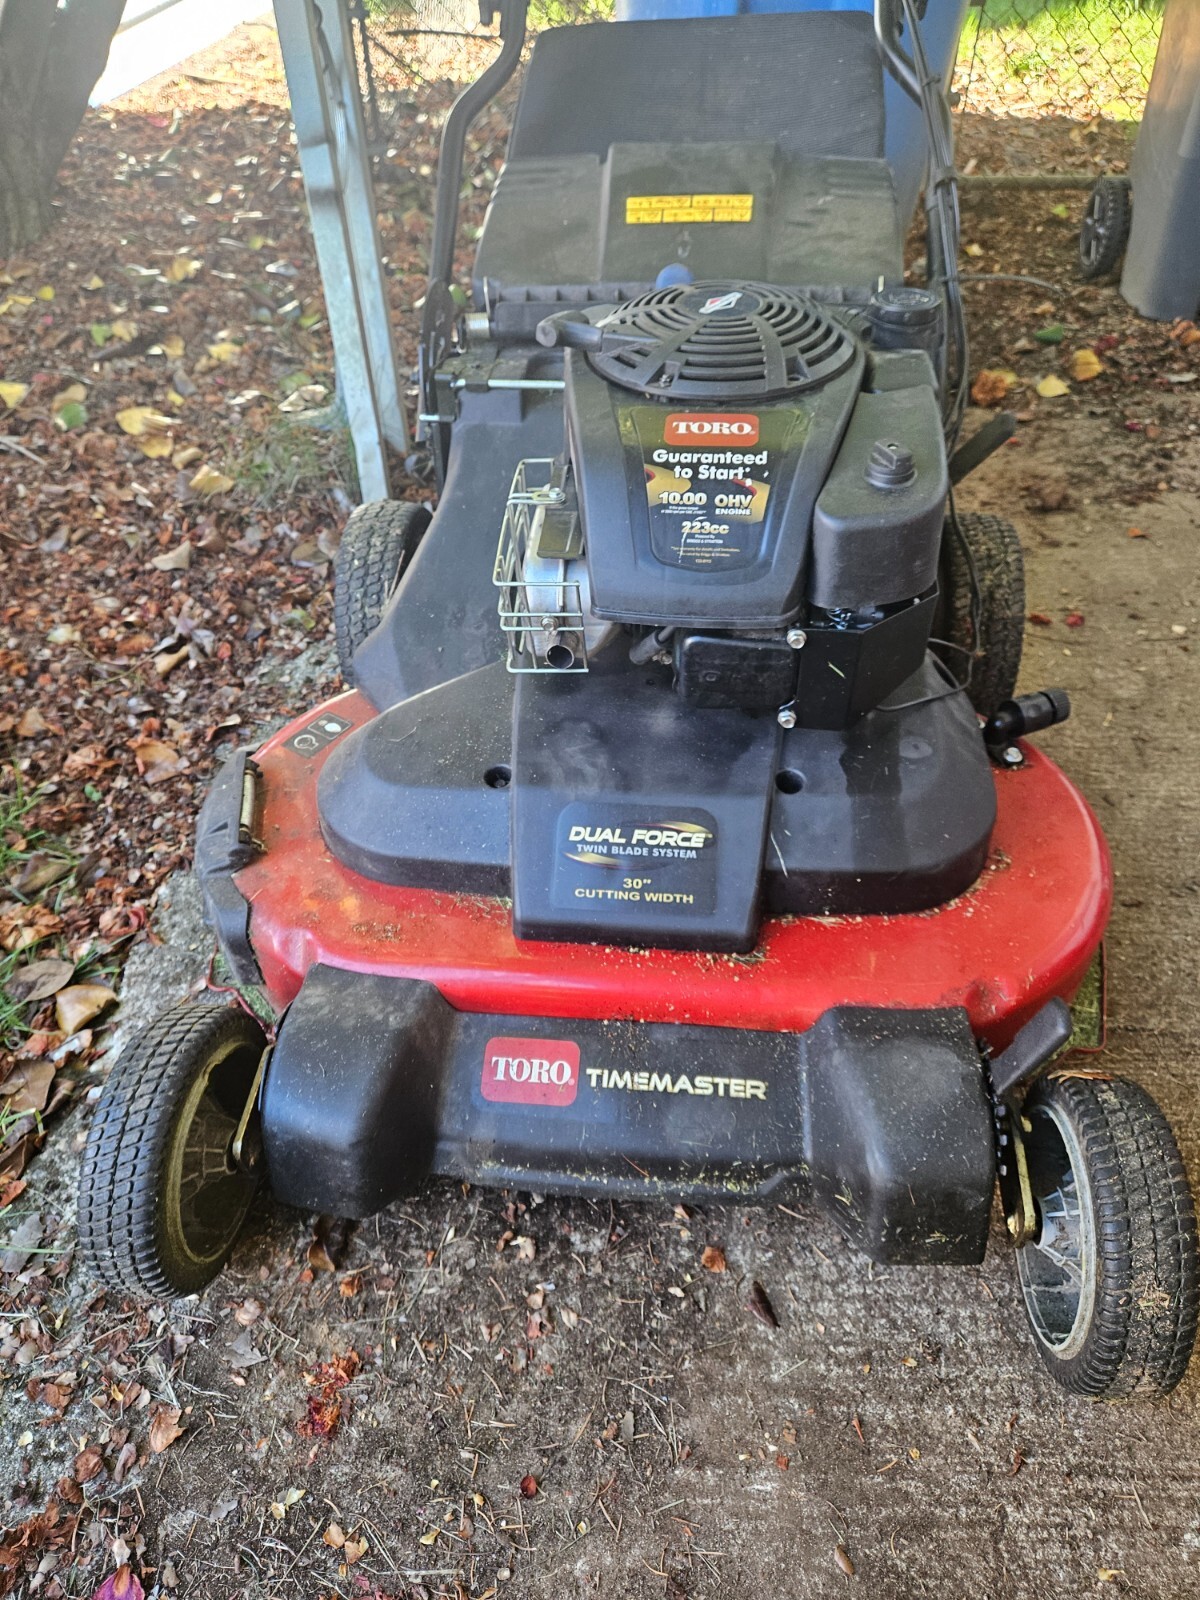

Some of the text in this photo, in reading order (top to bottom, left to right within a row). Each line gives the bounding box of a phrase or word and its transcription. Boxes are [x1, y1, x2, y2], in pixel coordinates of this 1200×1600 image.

[672, 421, 752, 435] TORO
[652, 448, 768, 465] Guaranteed
[674, 465, 693, 479] to
[659, 491, 707, 505] 10.00
[714, 494, 753, 508] OHV
[681, 521, 730, 534] 223cc
[568, 826, 706, 848] DUAL FORCE
[576, 844, 697, 859] TWIN BLADE SYSTEM
[574, 888, 694, 904] CUTTING WIDTH
[491, 1056, 766, 1100] TORO TIMEMASTER
